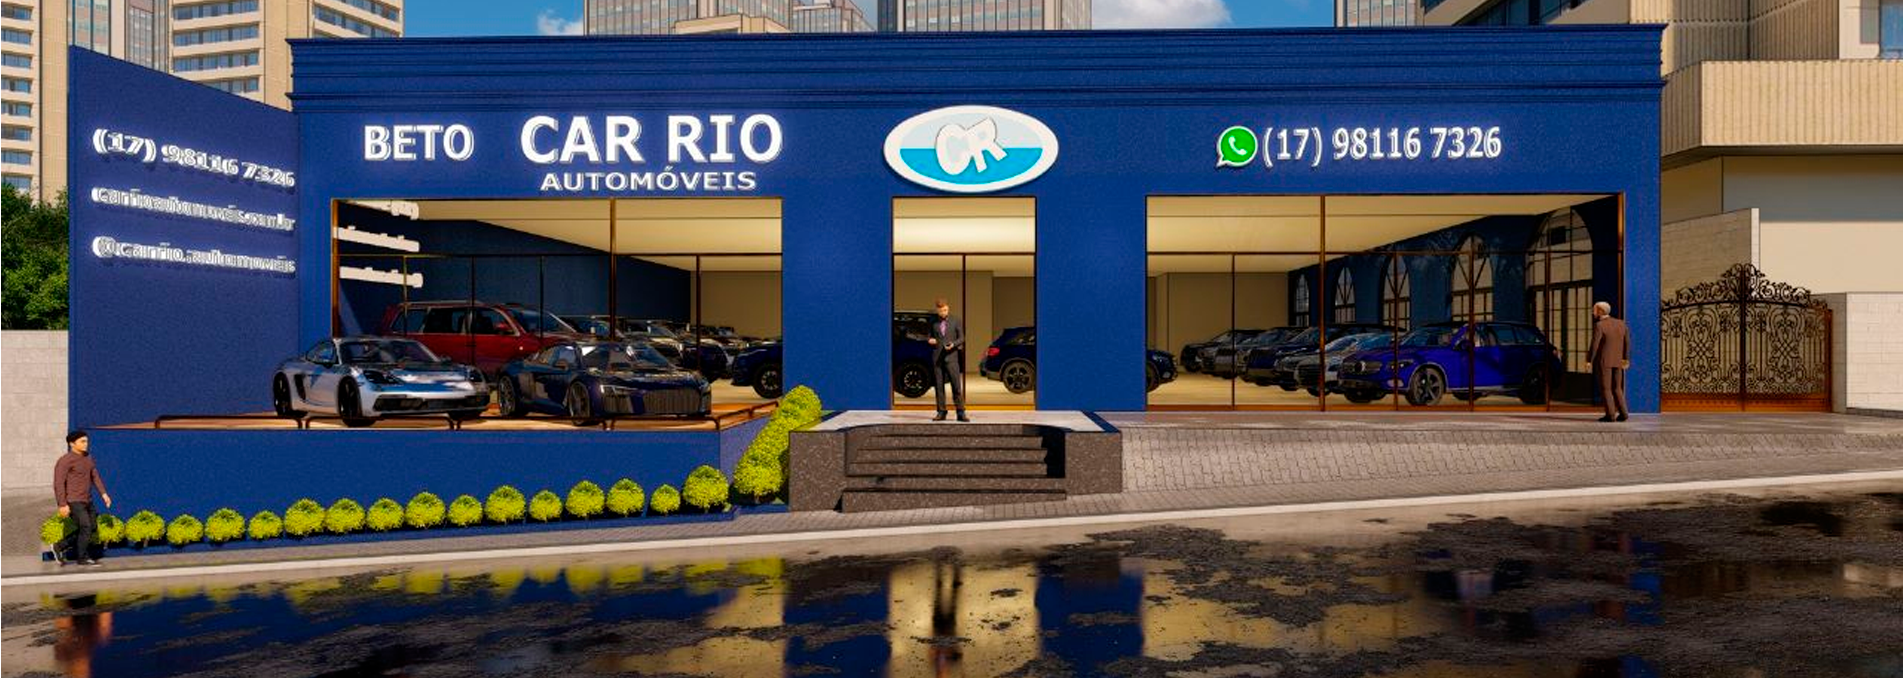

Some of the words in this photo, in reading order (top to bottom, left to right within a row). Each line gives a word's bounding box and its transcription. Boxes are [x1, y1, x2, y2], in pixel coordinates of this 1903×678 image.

[92, 128, 157, 163] (17)
[161, 144, 239, 176] 98116
[241, 161, 296, 188] 7326
[364, 124, 475, 161] BETO
[520, 115, 645, 163] CAR
[667, 114, 783, 163] RIO
[934, 117, 1007, 175] CR
[1262, 127, 1323, 167] (17)
[1331, 126, 1421, 160] 98116
[1429, 126, 1502, 160] 7326
[540, 166, 757, 192] AUTOMÓVEIS
